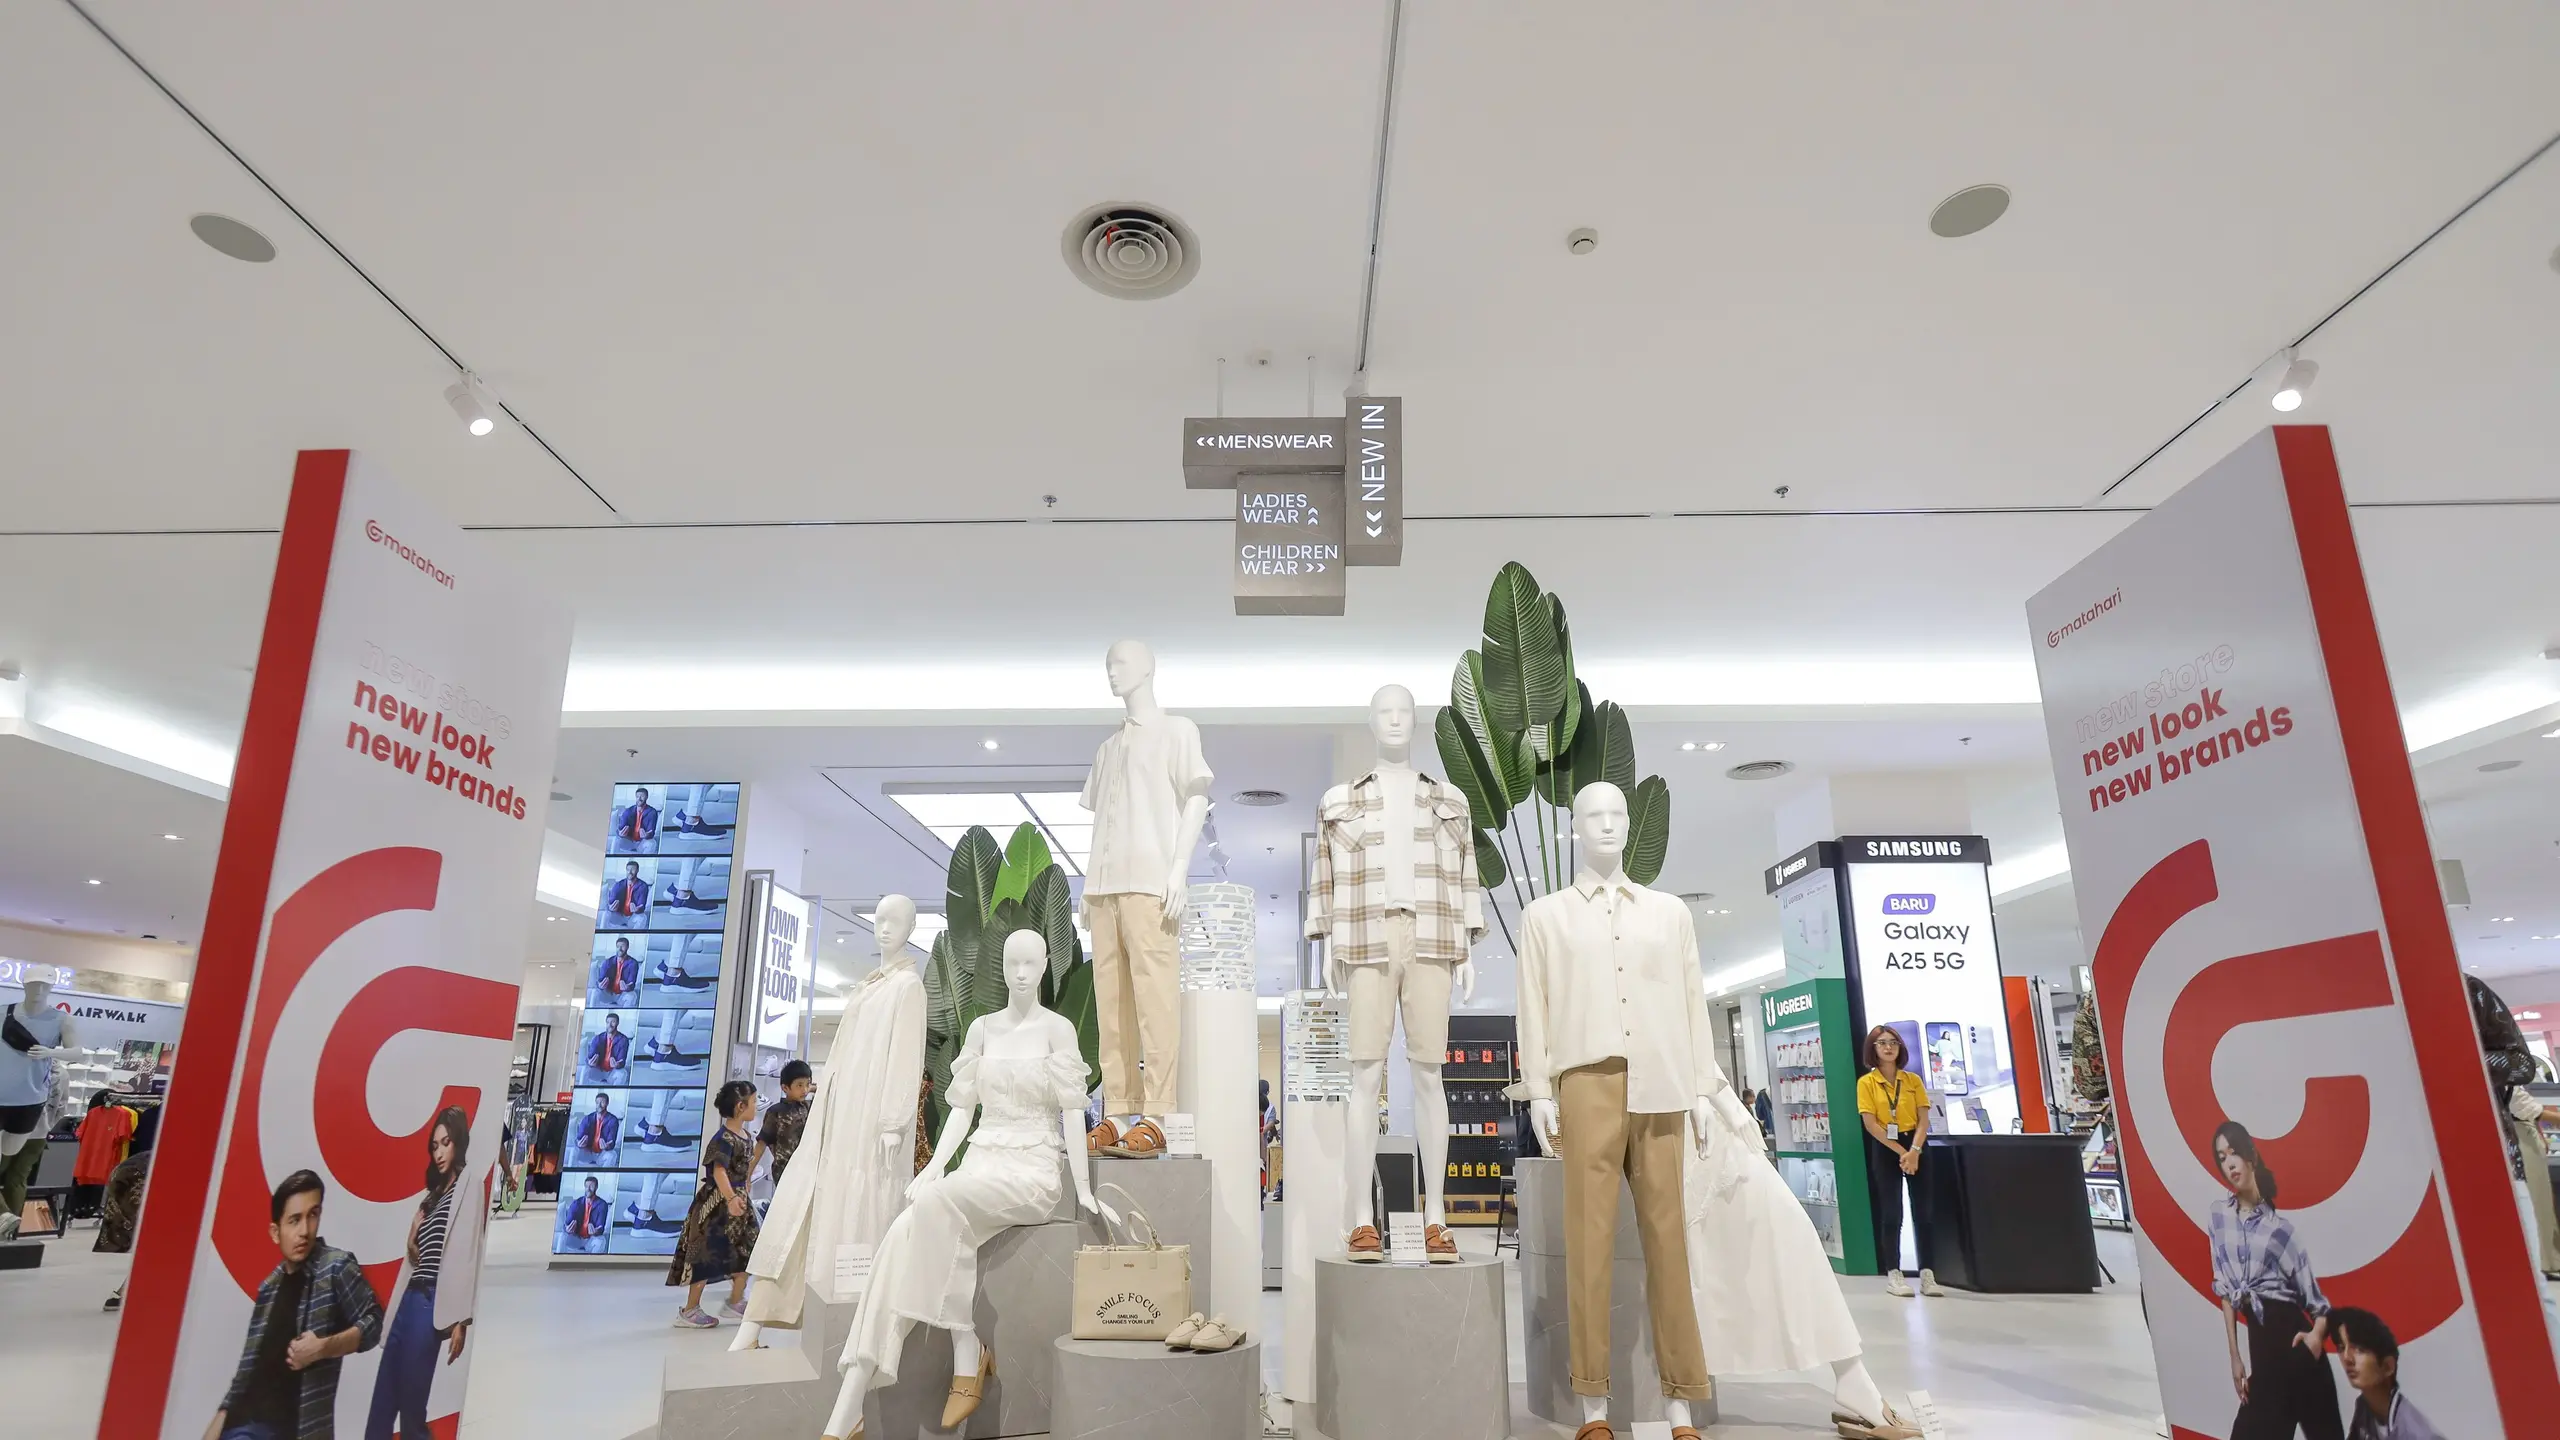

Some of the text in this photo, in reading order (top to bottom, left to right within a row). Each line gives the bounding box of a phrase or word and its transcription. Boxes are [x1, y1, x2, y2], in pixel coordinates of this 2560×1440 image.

[1218, 434, 1333, 449] MENSWEAR
[1361, 405, 1385, 501] NEW IN
[1243, 494, 1307, 508] LADIES
[1242, 509, 1299, 524] WEAR
[384, 533, 455, 590] matahari
[1241, 544, 1338, 560] CHILDREN
[1241, 560, 1299, 575] WEAR
[2060, 587, 2122, 639] matahari
[360, 640, 513, 740] new store
[2076, 644, 2235, 744] new store
[354, 679, 496, 770] new look
[2082, 687, 2228, 776] new look
[346, 720, 527, 820] new brands
[2088, 706, 2294, 812] new brands
[1866, 841, 1962, 857] SAMSUNG
[1783, 856, 1807, 878] UGREEN
[1890, 898, 1929, 911] BARU
[768, 906, 799, 944] OWN
[1884, 922, 1970, 945] Galaxy
[771, 937, 793, 971] THE
[1886, 952, 1965, 970] A25 5G
[763, 967, 797, 1004] LOOR
[73, 1006, 148, 1024] AIRWALK
[1777, 994, 1813, 1017] UGREEN
[1096, 1292, 1161, 1319] SMILE FOCUS
